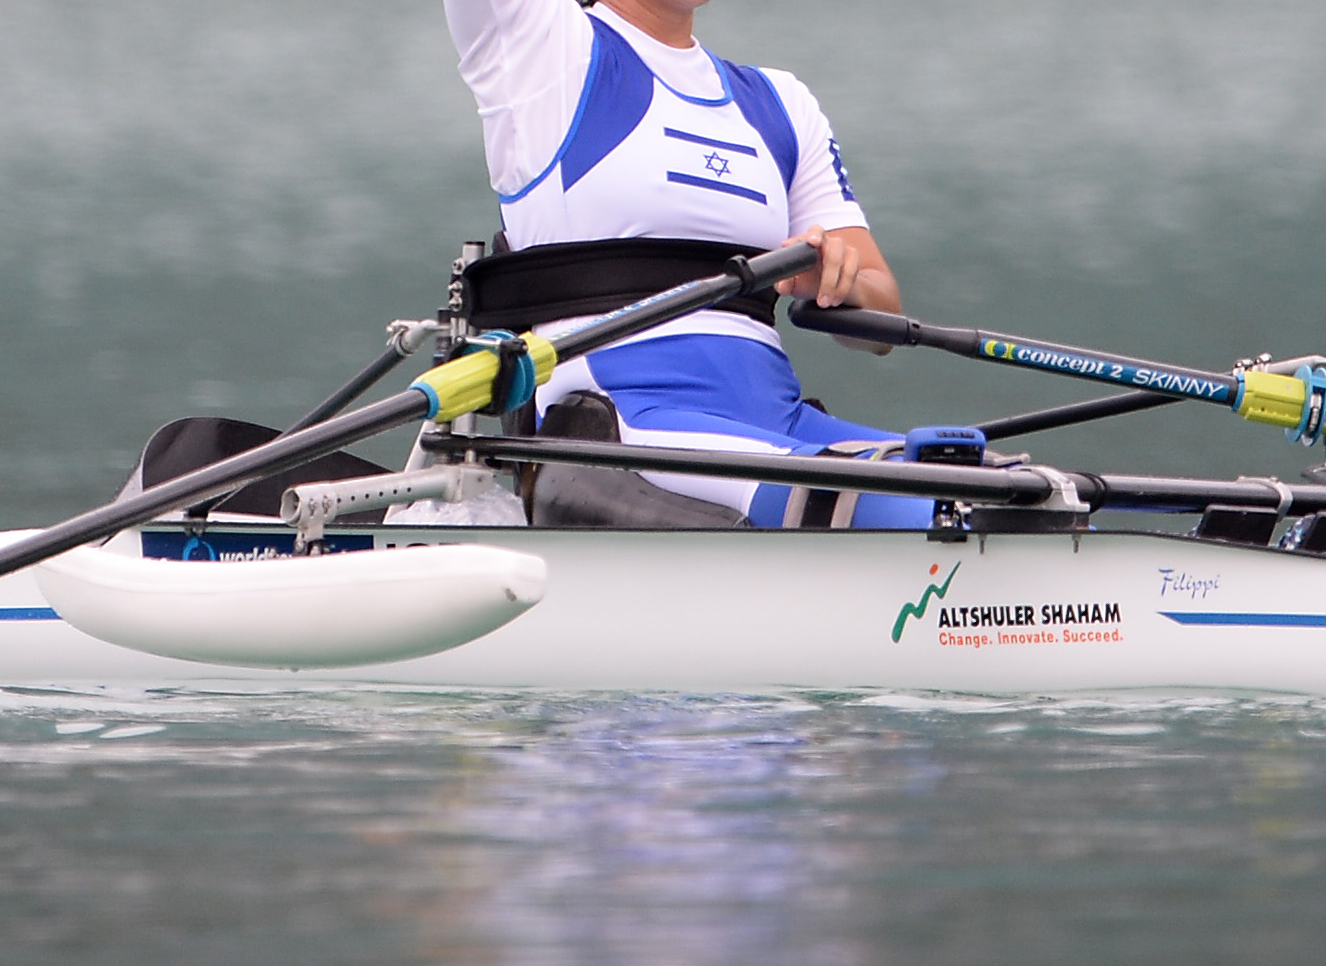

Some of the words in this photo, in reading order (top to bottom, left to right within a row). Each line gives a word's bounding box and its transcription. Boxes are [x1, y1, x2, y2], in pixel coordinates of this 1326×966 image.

[1016, 346, 1104, 375] concept
[1109, 365, 1124, 378] 2
[1132, 369, 1224, 397] SKINNY
[1158, 568, 1221, 599] Filippi
[938, 605, 1036, 629] ALTSHULER
[1041, 603, 1122, 625] SHAHAM
[939, 632, 993, 648] Change.
[998, 631, 1059, 644] Innovate.
[1063, 629, 1124, 643] Succeed.
